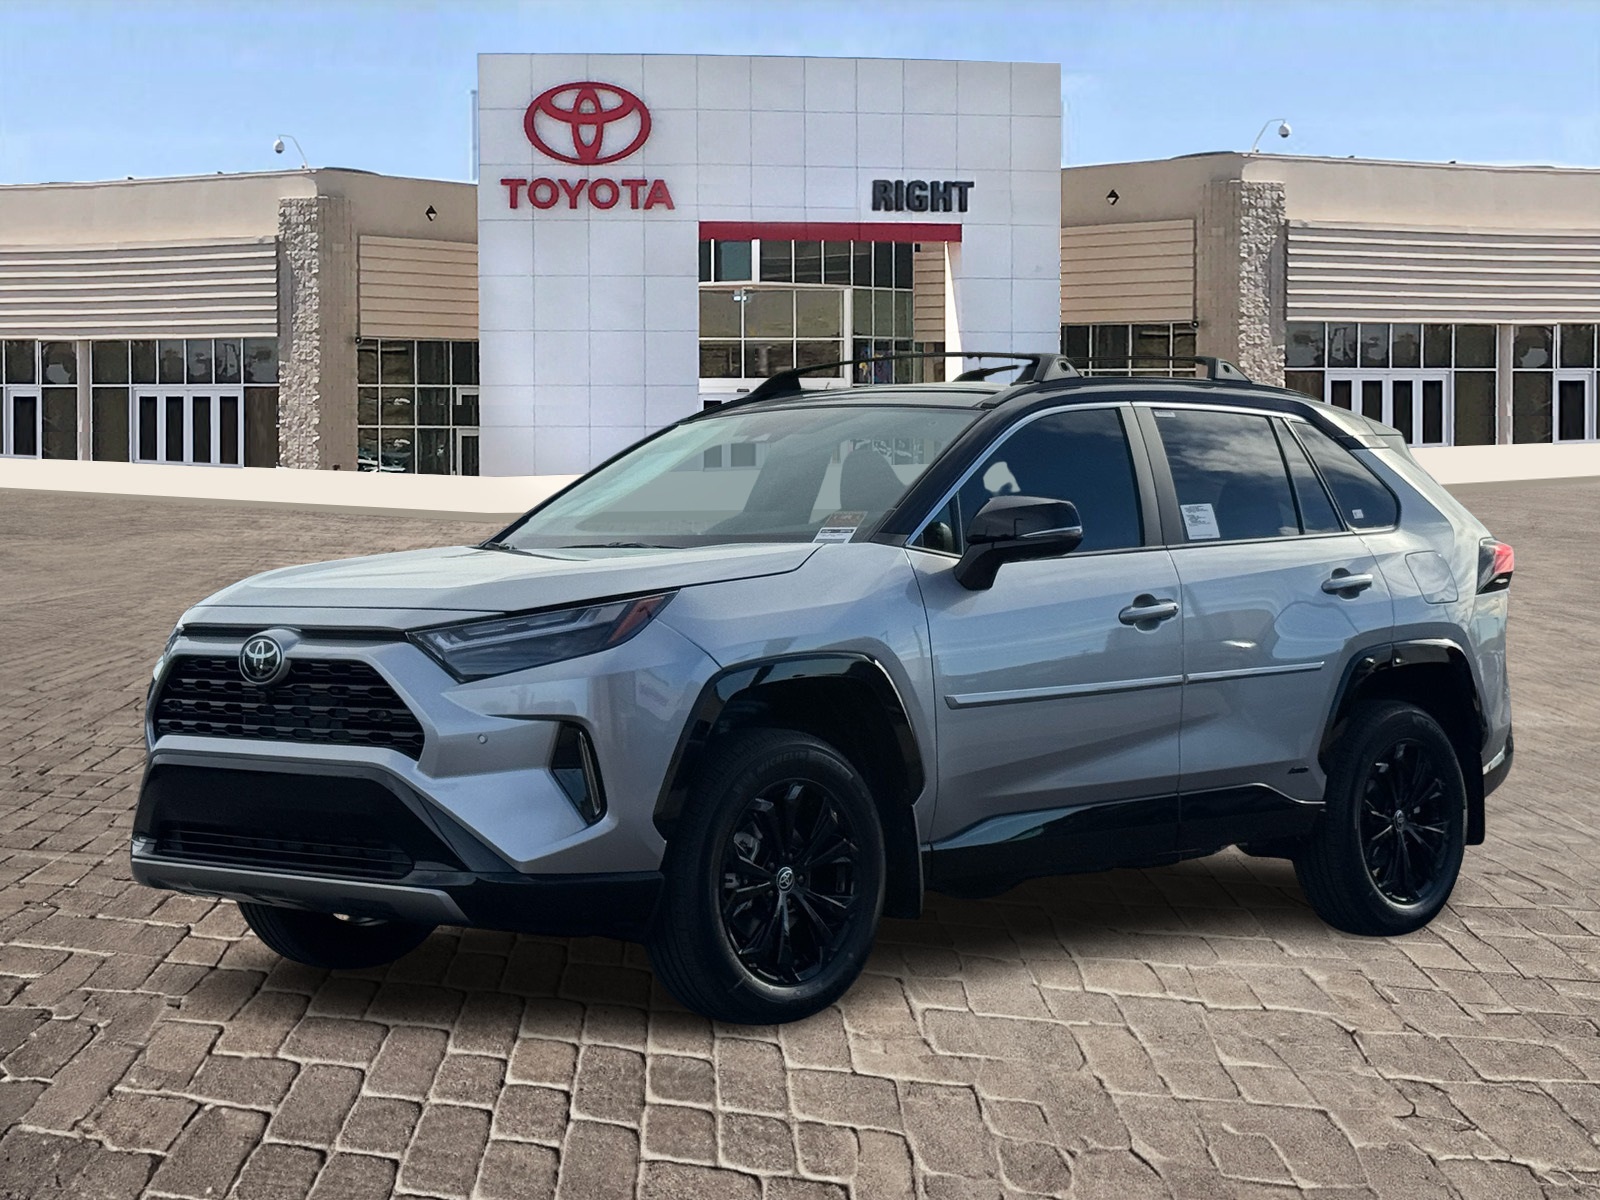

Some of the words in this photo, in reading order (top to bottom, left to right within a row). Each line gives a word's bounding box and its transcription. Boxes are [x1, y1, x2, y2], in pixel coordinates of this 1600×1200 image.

[500, 178, 675, 209] TOYOTA
[872, 180, 975, 212] RIGHT
[757, 750, 808, 774] MICHELIN
